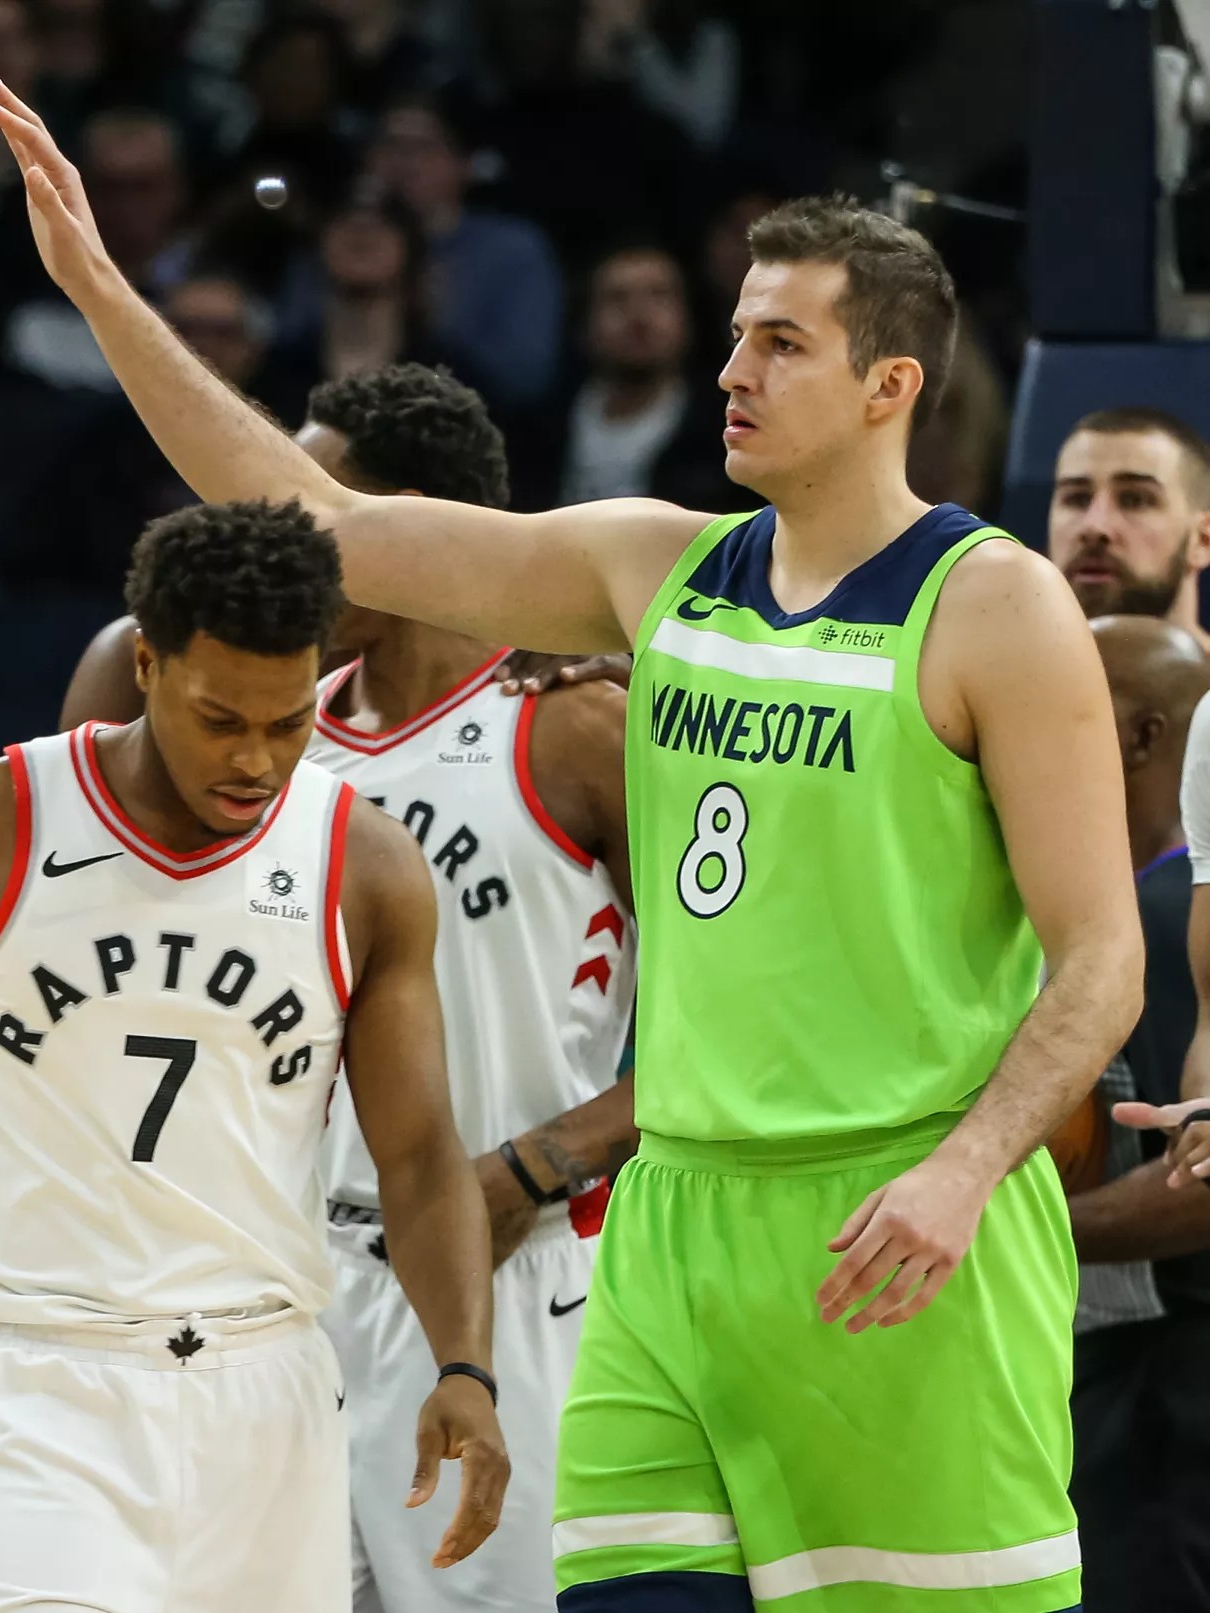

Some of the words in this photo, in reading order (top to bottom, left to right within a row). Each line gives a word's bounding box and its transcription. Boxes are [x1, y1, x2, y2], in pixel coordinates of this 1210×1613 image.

[840, 628, 885, 648] fitbit
[650, 679, 856, 773] MINNESOTA
[437, 752, 463, 763] Sun
[676, 781, 749, 920] 8
[249, 899, 278, 916] Sun
[281, 905, 309, 921] Life
[123, 1034, 197, 1163] 7
